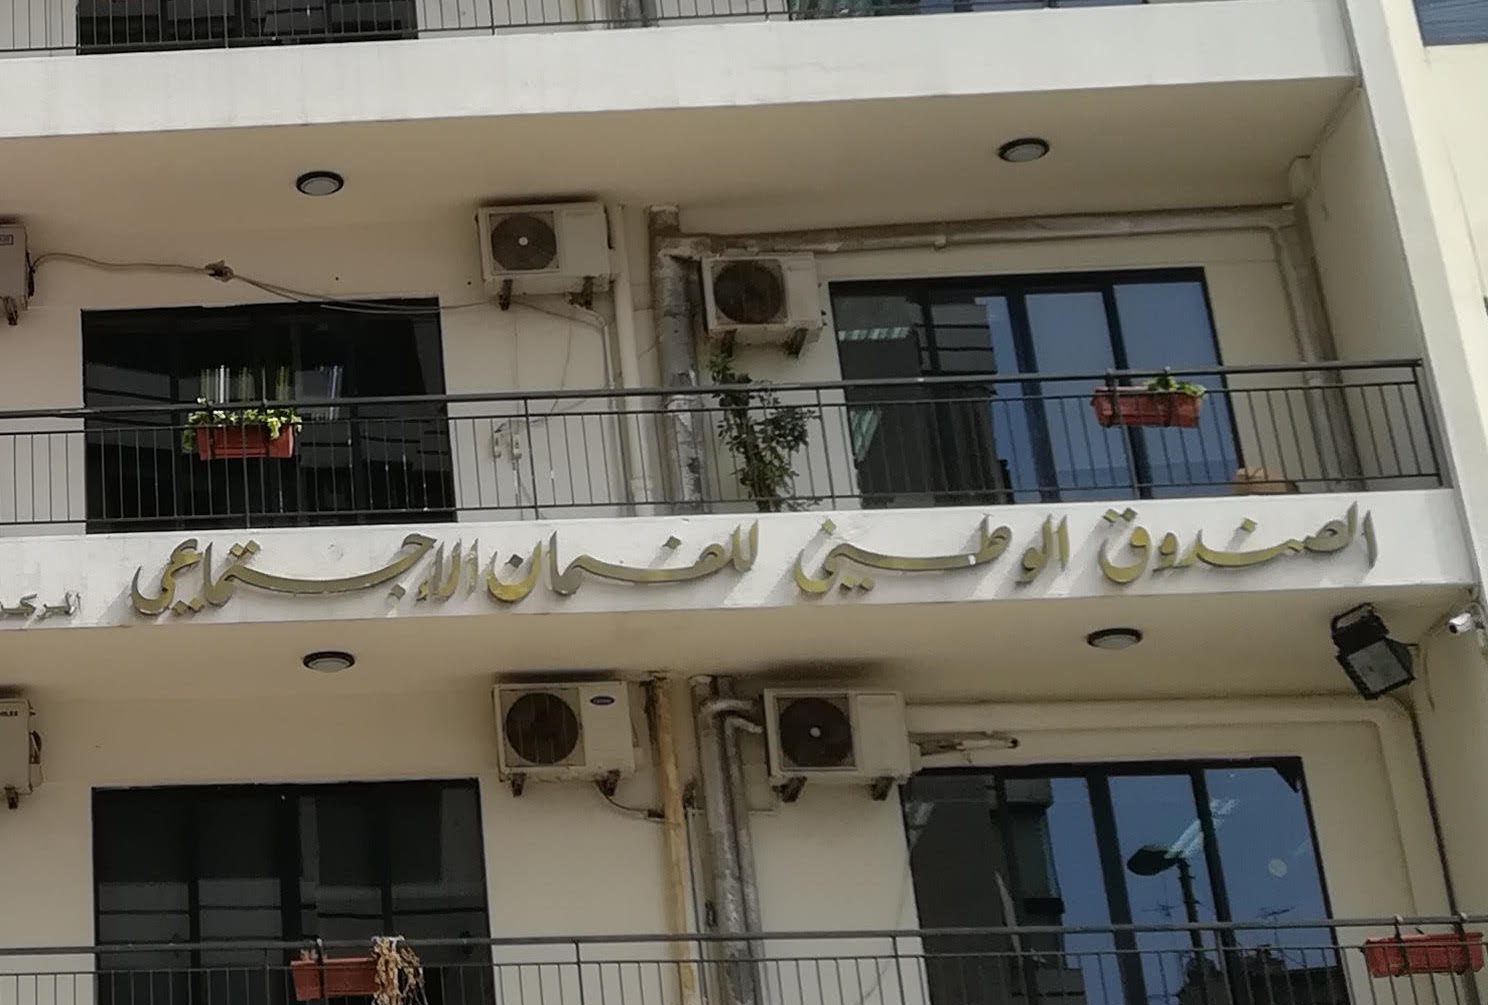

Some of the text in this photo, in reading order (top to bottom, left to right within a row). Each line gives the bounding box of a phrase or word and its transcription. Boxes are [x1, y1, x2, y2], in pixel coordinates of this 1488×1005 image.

[131, 532, 479, 616] الاجتماعي
[794, 513, 1070, 594] الوطني
[1098, 500, 1379, 584] الصندوق
